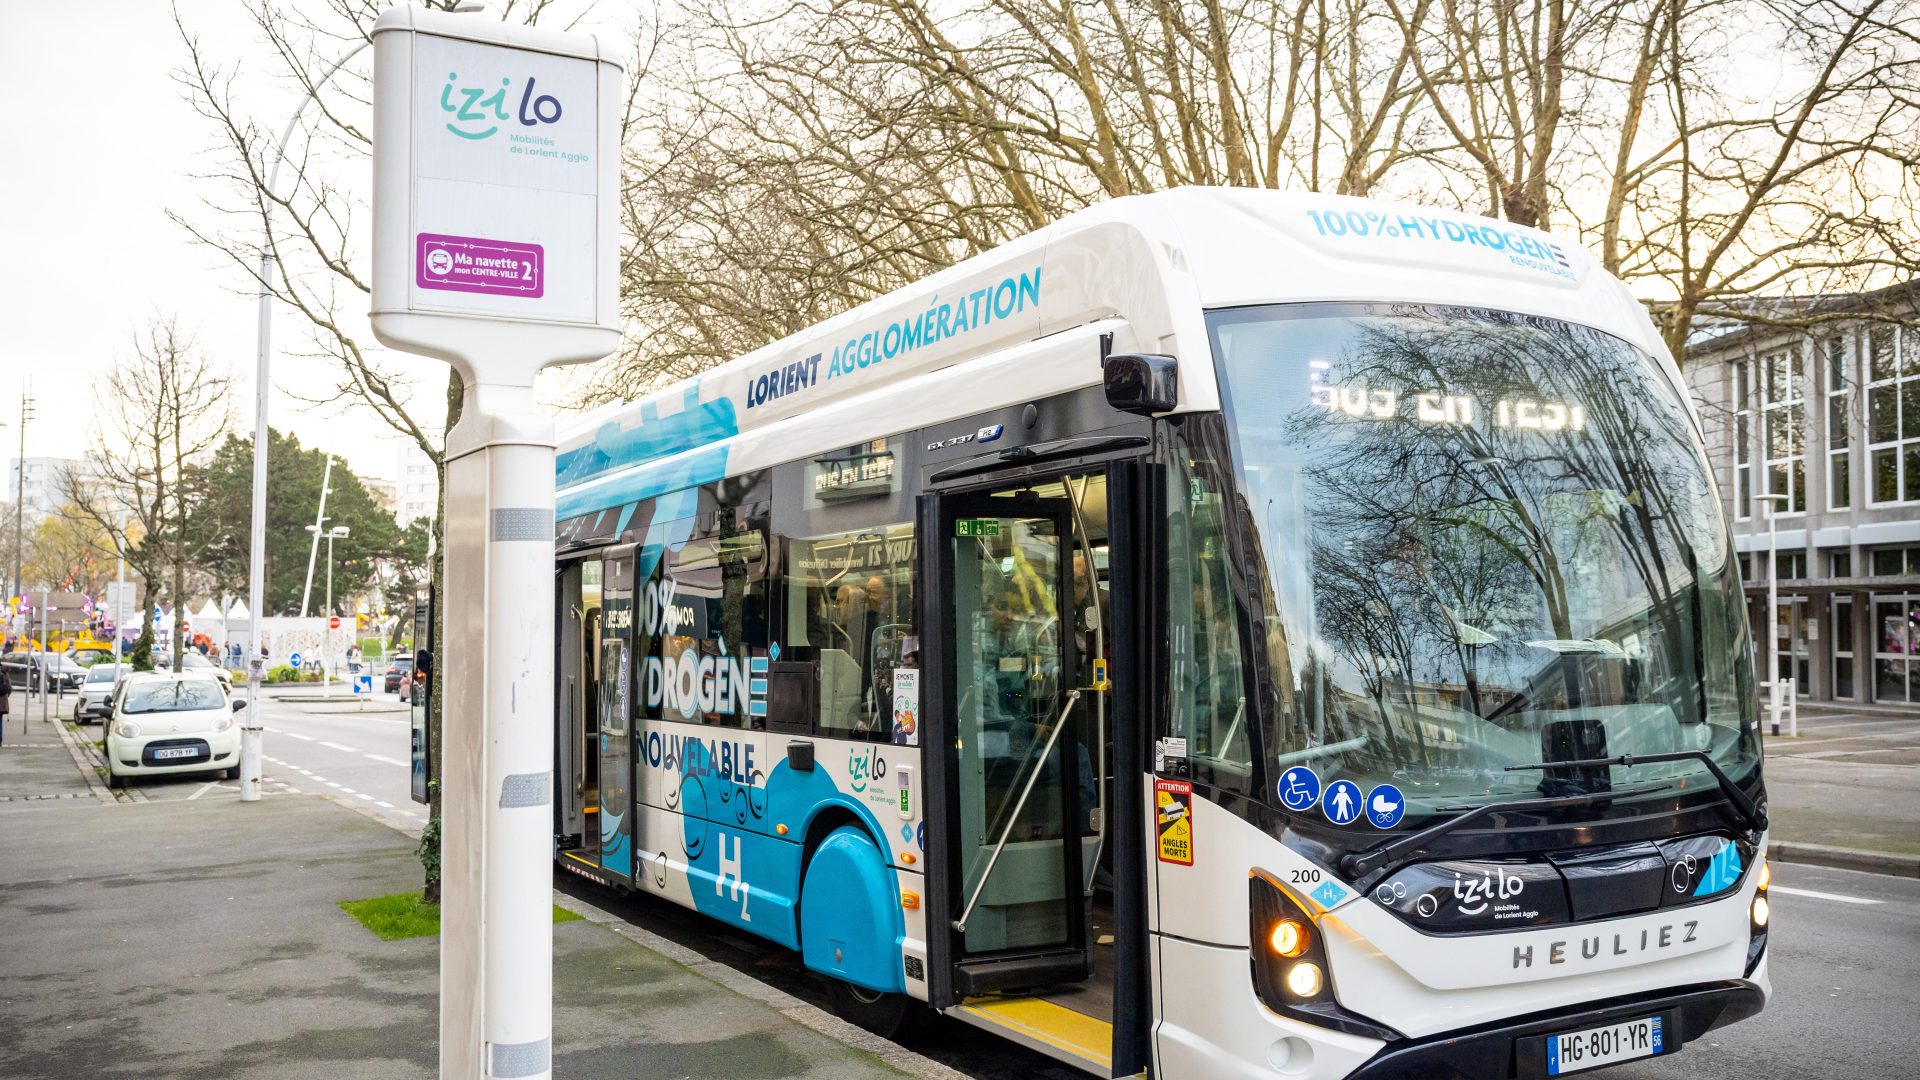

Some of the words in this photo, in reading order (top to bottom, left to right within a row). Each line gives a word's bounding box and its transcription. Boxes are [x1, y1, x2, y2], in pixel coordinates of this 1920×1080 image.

[510, 133, 555, 147] Mobilités
[510, 145, 523, 155] de
[525, 146, 558, 158] Lorient
[560, 151, 589, 163] Agglo
[455, 252, 473, 266] Ma
[475, 255, 518, 269] navette
[455, 267, 470, 276] mon
[471, 267, 518, 279] CENTRE-VILLE
[521, 261, 532, 281] 2
[747, 353, 822, 409] LORIENT
[828, 266, 1042, 380] AGGLOMÉRATION
[927, 441, 945, 450] GX
[948, 434, 975, 446] 337
[1158, 782, 1189, 792] ATTENTION
[1162, 837, 1188, 849] ANGLES
[1163, 847, 1187, 858] MORTS
[1291, 869, 1321, 883] 200
[1494, 904, 1520, 912] Mobilités
[1503, 911, 1522, 919] Lorient
[1523, 910, 1538, 919] Agglo
[1513, 920, 1698, 969] HEULIEZ
[1561, 1023, 1648, 1064] HG-801-YR
[1653, 1035, 1662, 1047] 56
